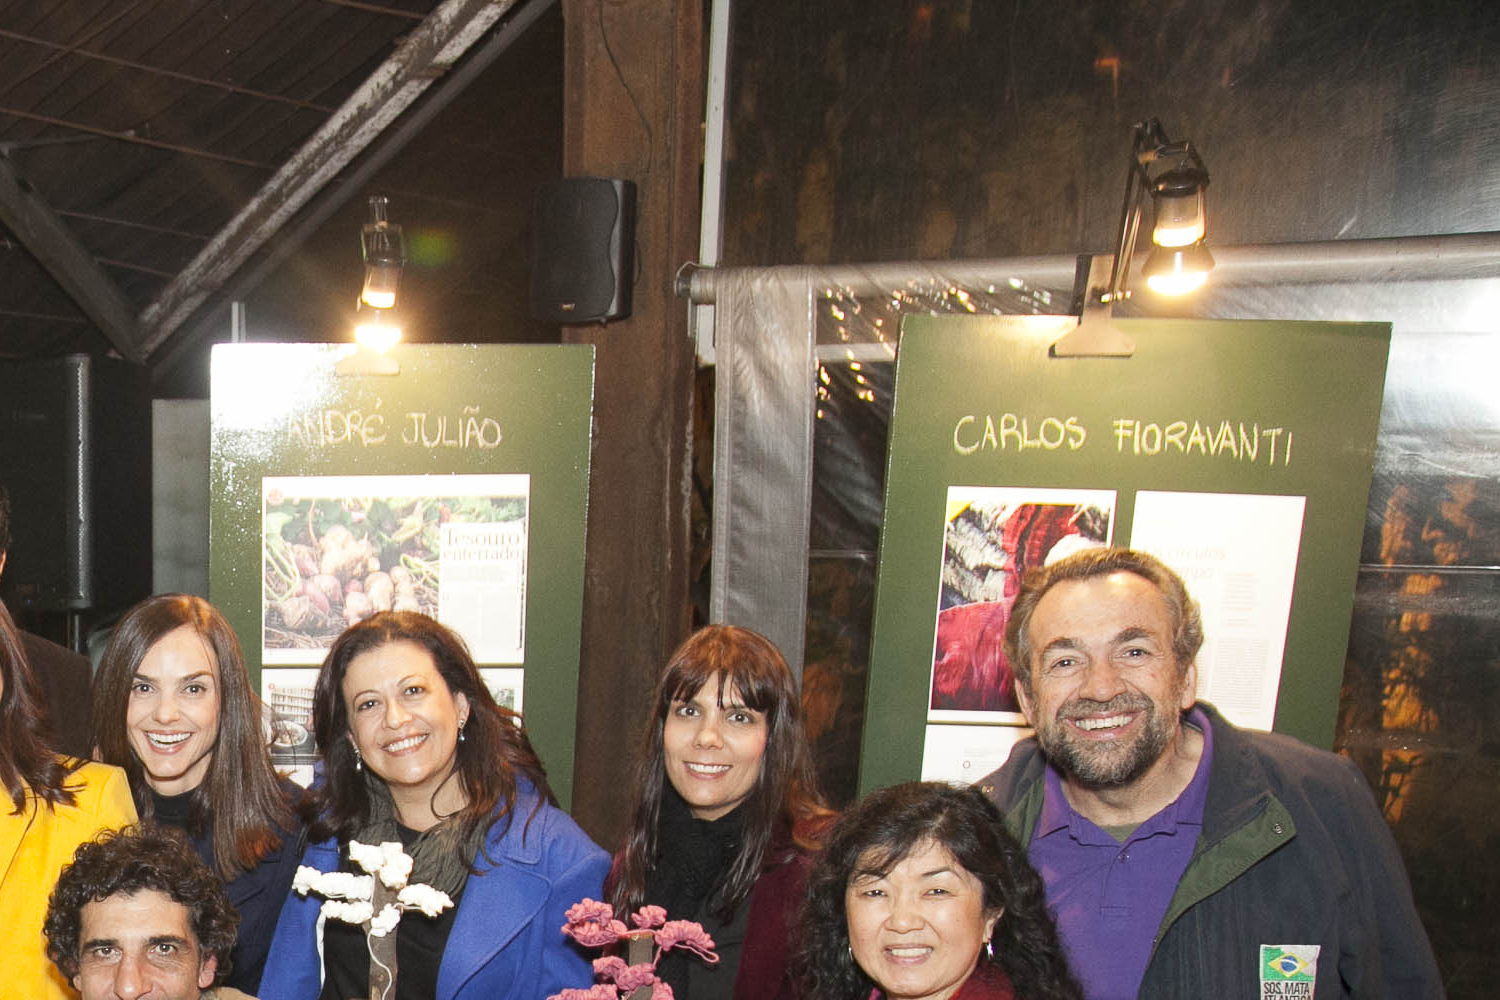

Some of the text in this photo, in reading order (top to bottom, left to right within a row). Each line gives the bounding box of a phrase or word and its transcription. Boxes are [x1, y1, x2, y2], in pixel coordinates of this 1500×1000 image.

[287, 398, 502, 449] ANDRÉ JULIÃO
[953, 413, 1292, 466] CARLOS FIORAVANTI
[443, 527, 520, 546] Tesouro
[1285, 982, 1310, 995] MATA
